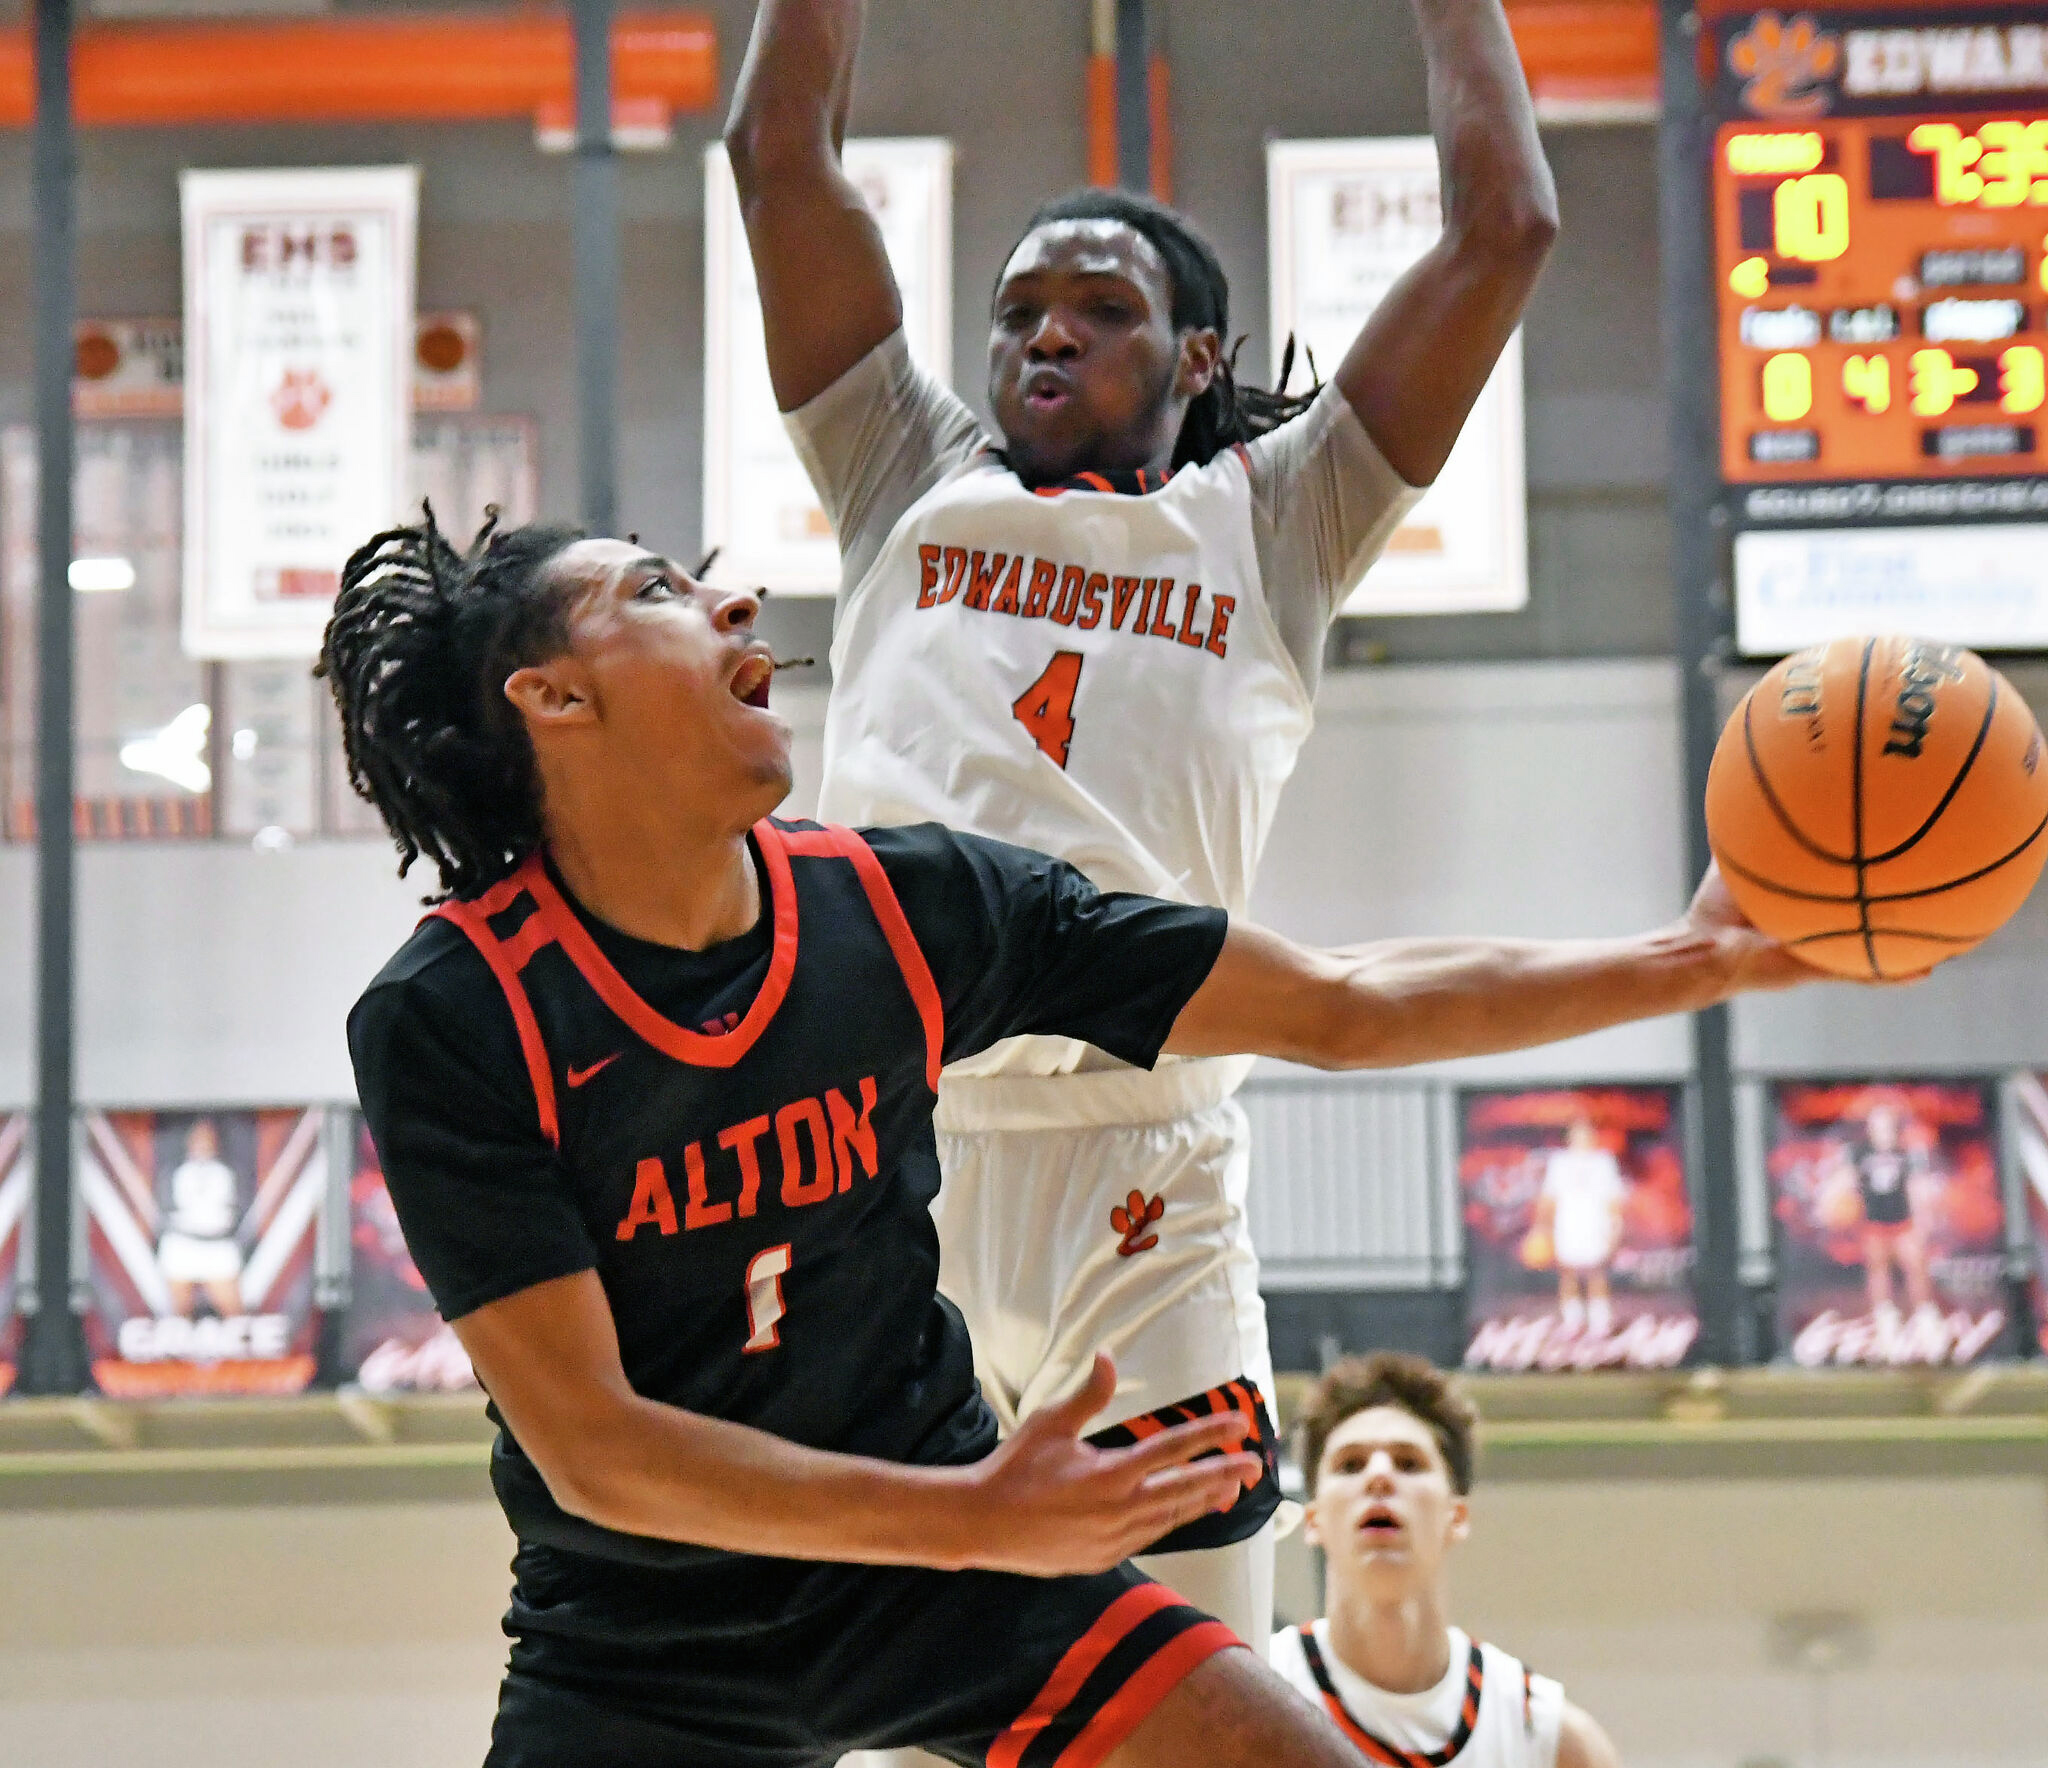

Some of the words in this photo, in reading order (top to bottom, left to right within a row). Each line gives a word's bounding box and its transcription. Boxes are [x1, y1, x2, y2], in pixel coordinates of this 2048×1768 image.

[916, 544, 1236, 660] EDWARDSVILLE
[1011, 650, 1083, 770] 4
[615, 1075, 879, 1242] ALTON
[741, 1243, 792, 1355] 1
